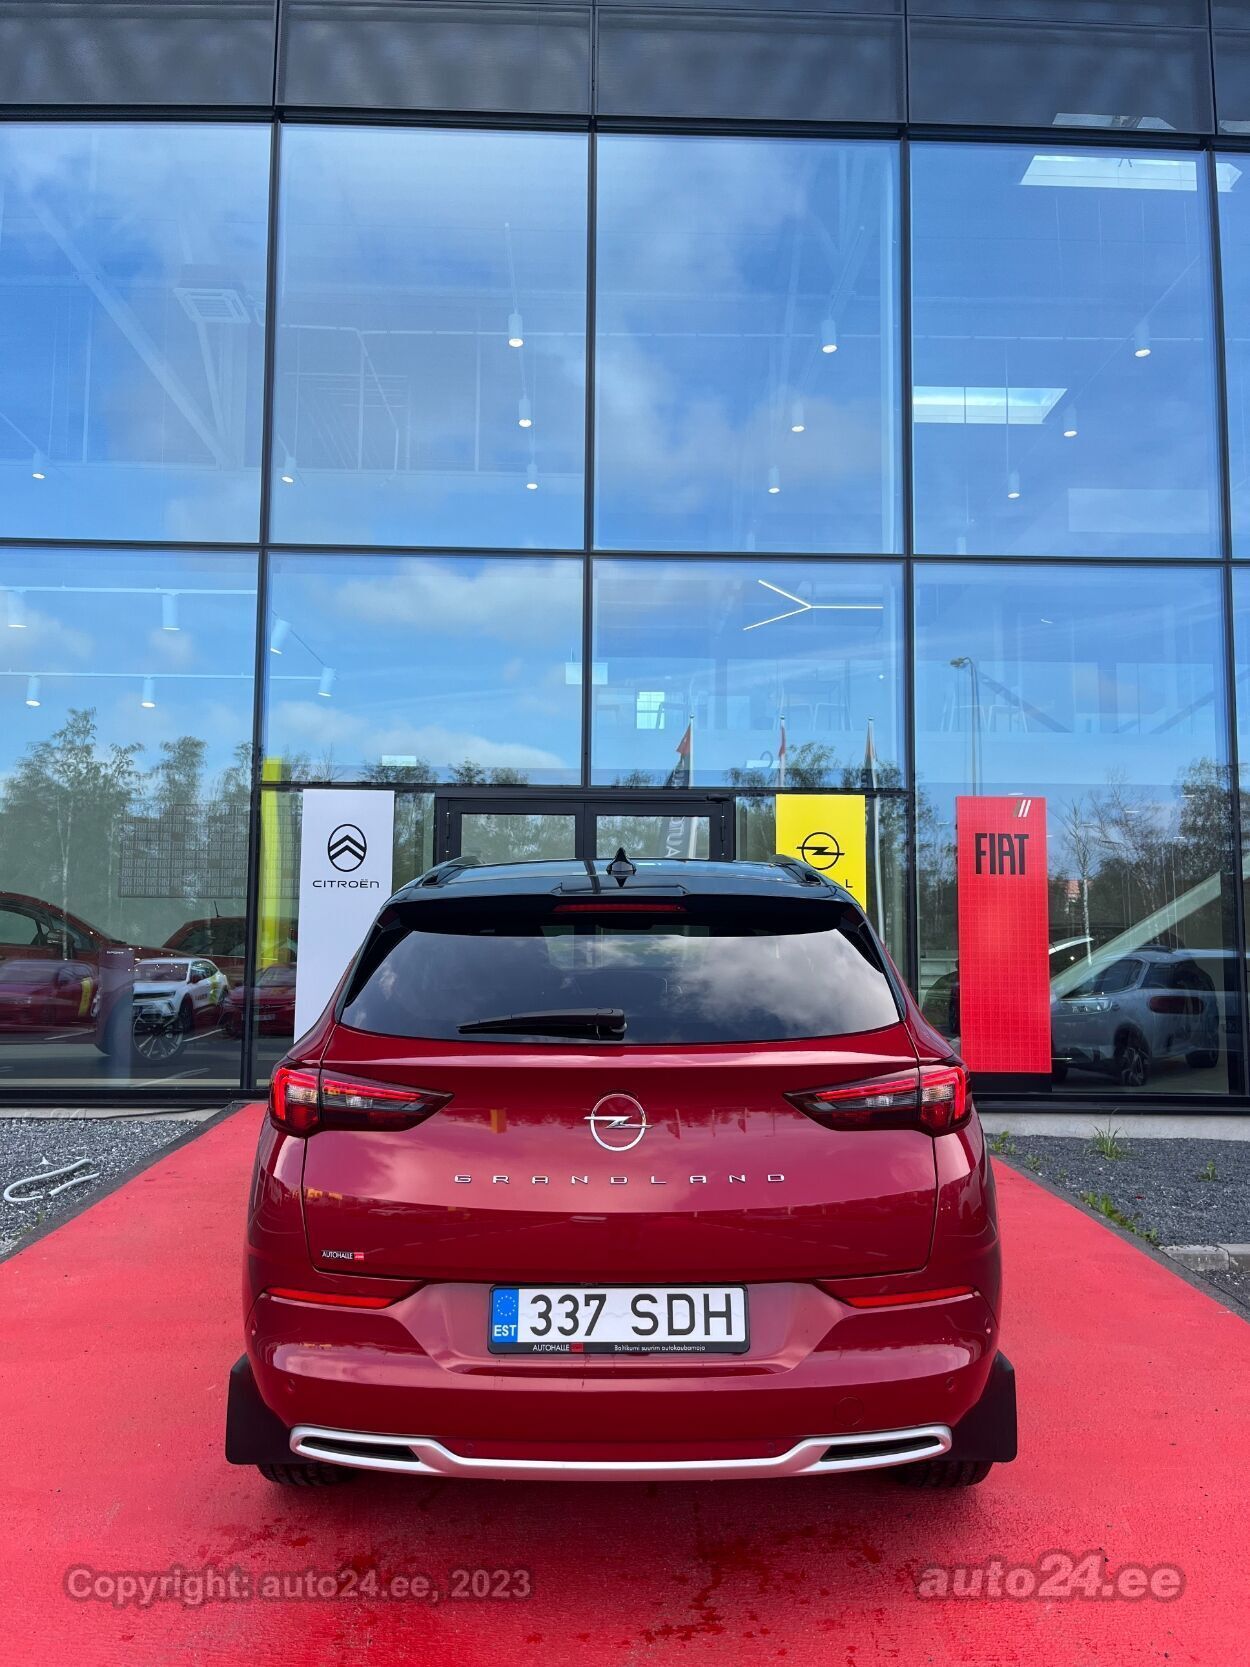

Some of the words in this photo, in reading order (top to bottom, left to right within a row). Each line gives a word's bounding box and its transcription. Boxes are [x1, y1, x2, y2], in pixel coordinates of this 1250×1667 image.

[975, 833, 1029, 875] FIAT
[312, 878, 380, 889] CITROËN
[454, 1174, 785, 1185] GRANDLAND
[322, 1251, 353, 1260] AUTOHALLE
[529, 1293, 607, 1337] 337
[630, 1293, 733, 1337] SDH
[494, 1324, 517, 1337] EST
[532, 1344, 570, 1352] AUTOHALLE
